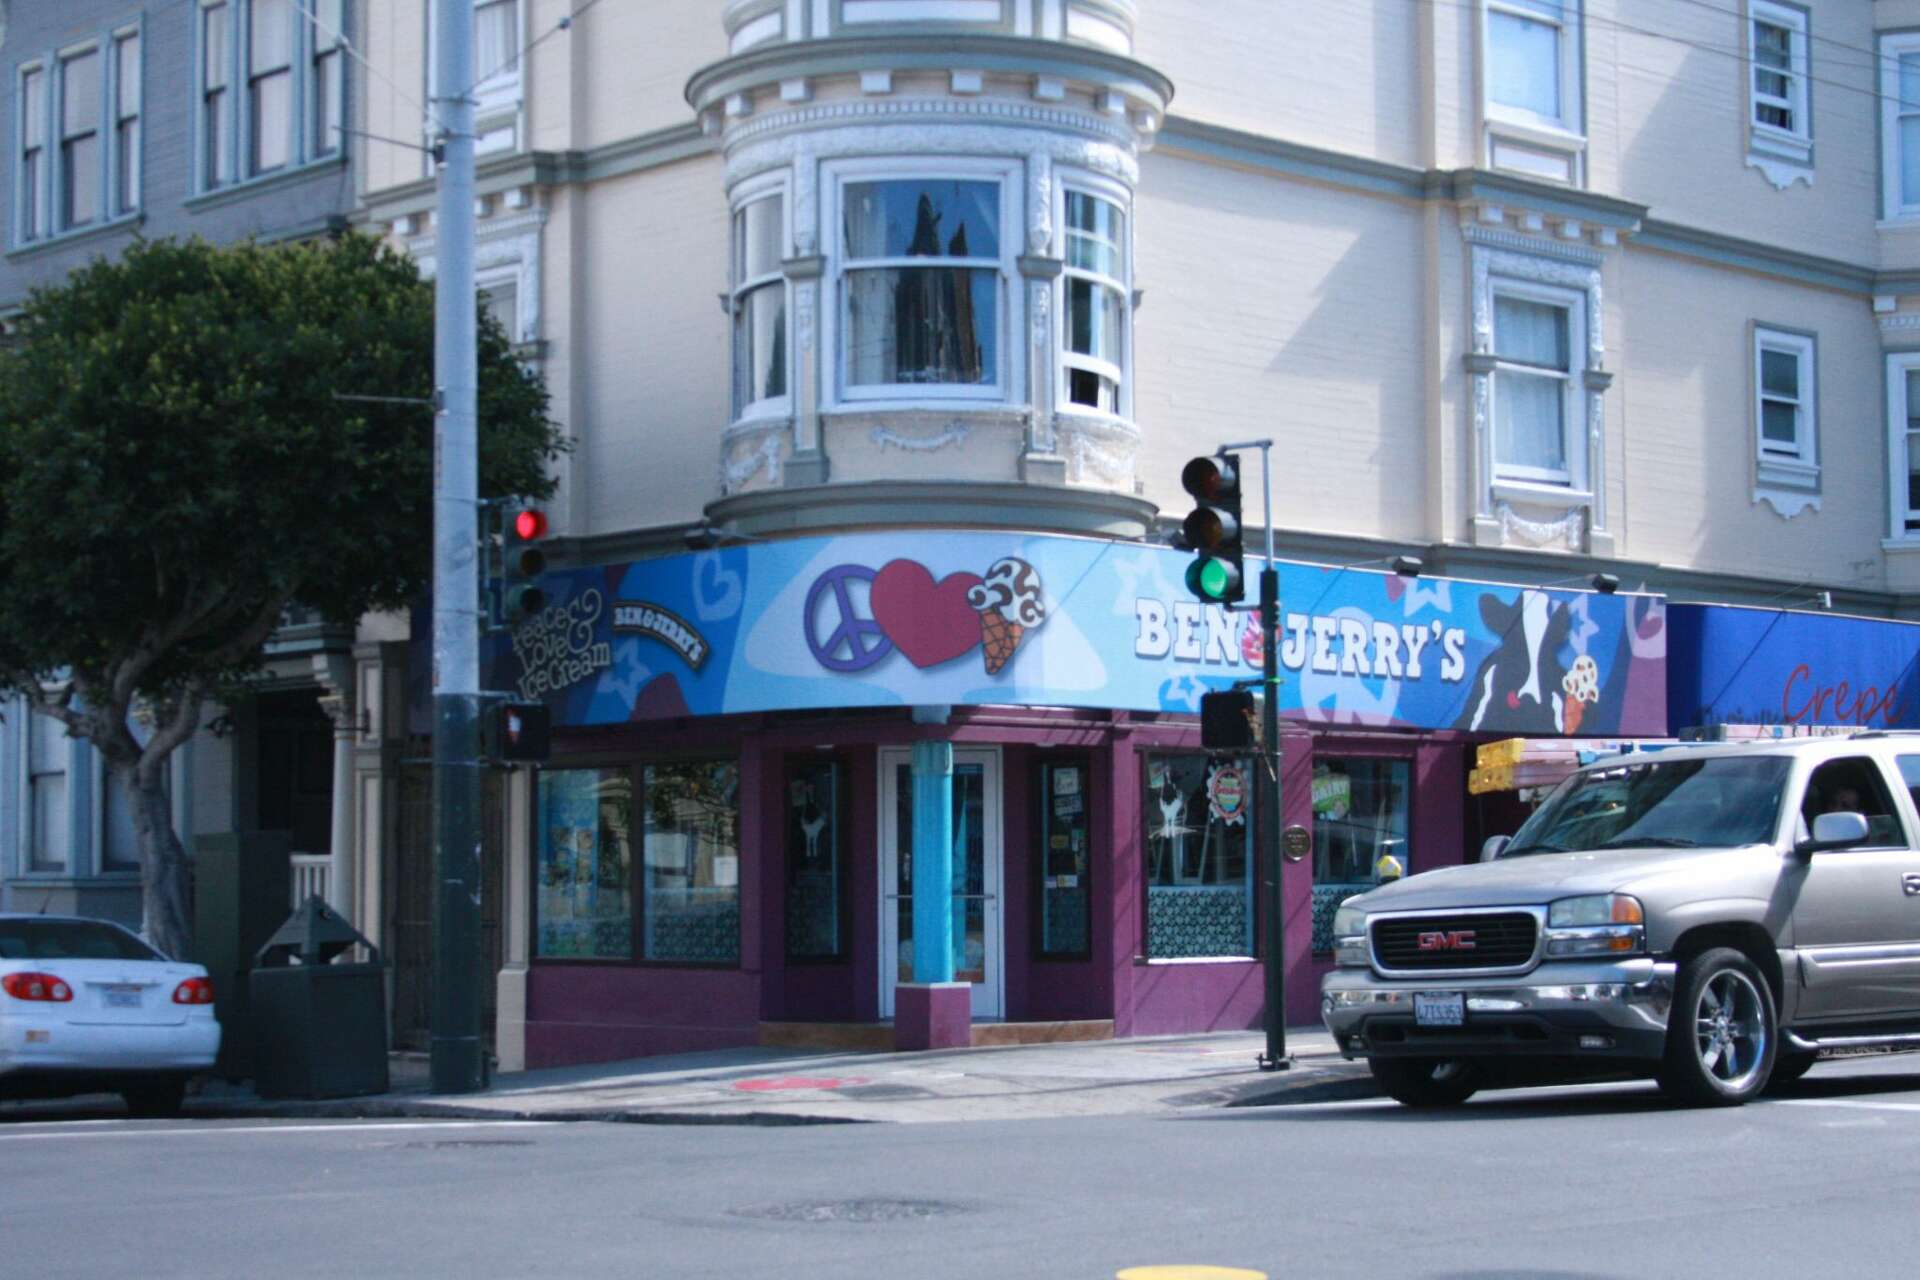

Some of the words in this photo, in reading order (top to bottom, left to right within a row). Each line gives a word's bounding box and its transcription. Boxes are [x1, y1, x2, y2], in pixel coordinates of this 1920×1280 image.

[614, 606, 643, 626] BEN
[517, 633, 568, 674] Love
[1135, 598, 1239, 663] BEN
[1281, 612, 1466, 681] JERRY'S
[1417, 930, 1477, 950] GMC
